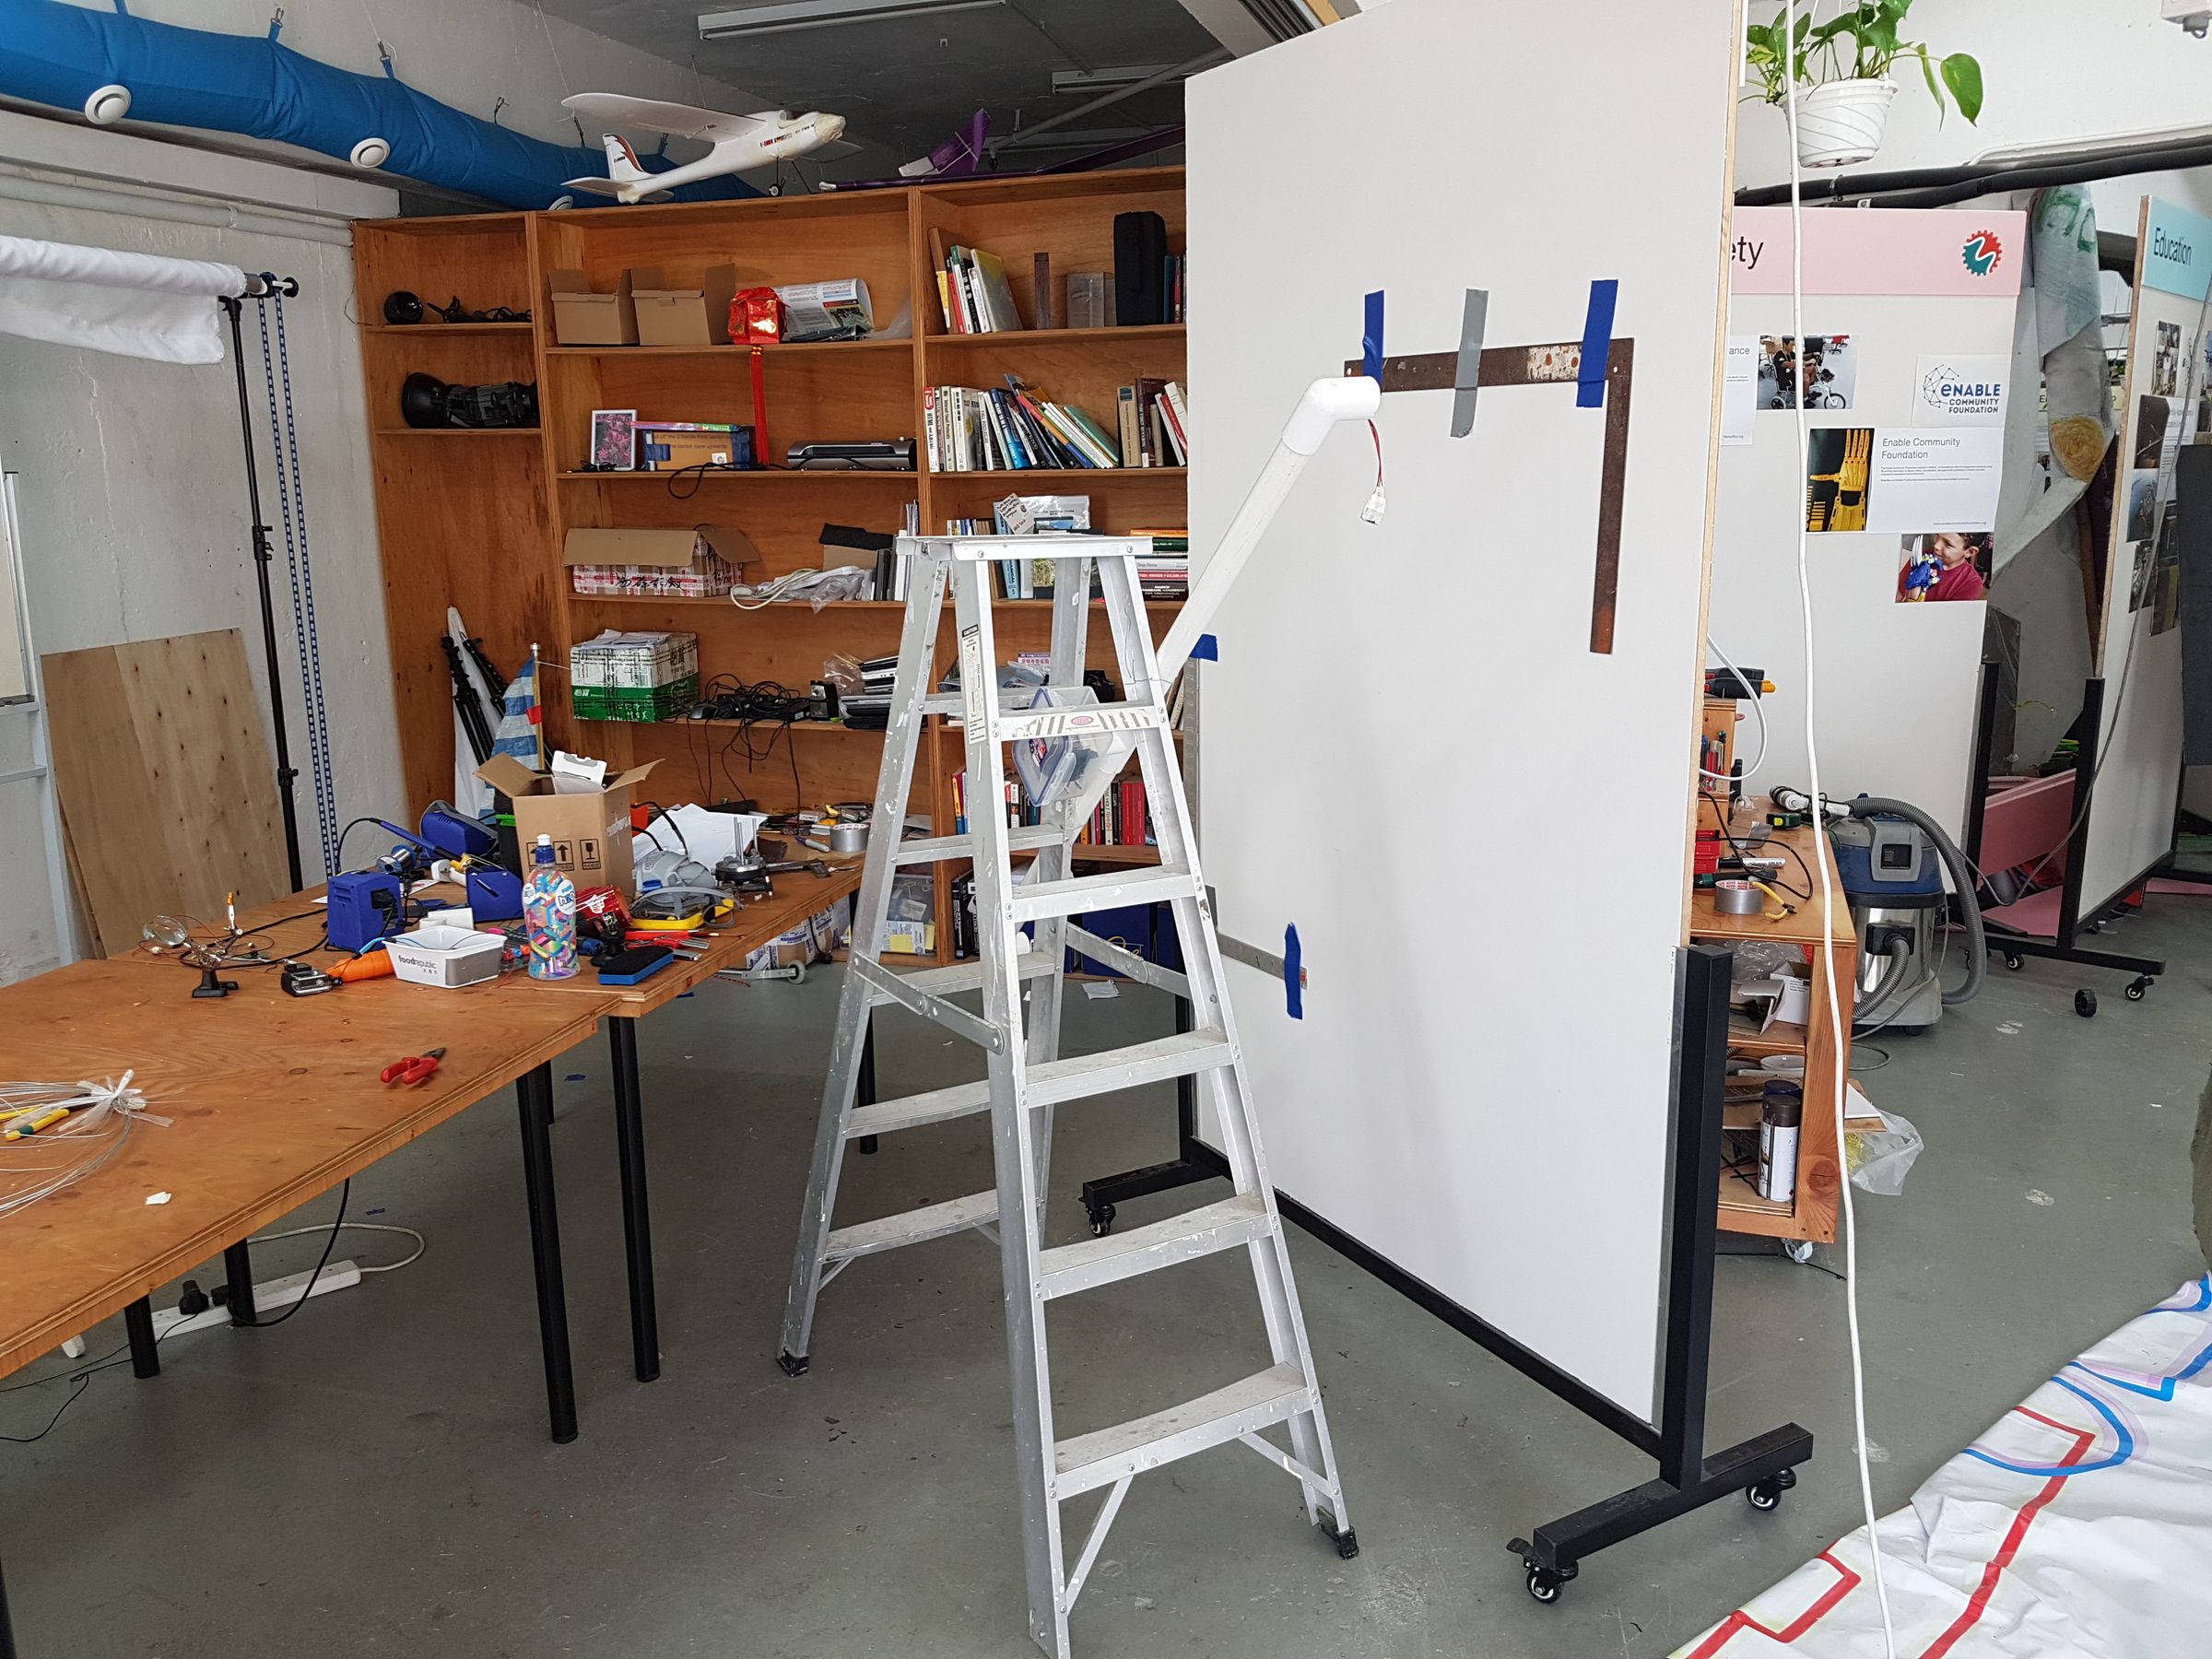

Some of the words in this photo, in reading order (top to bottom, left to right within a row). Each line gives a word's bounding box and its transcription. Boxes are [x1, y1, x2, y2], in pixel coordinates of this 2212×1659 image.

[2153, 226, 2193, 266] Education
[1882, 438, 1911, 447] Enable
[1912, 437, 1961, 448] Community
[1881, 450, 1928, 459] Foundation
[398, 954, 438, 970] foodrepublic
